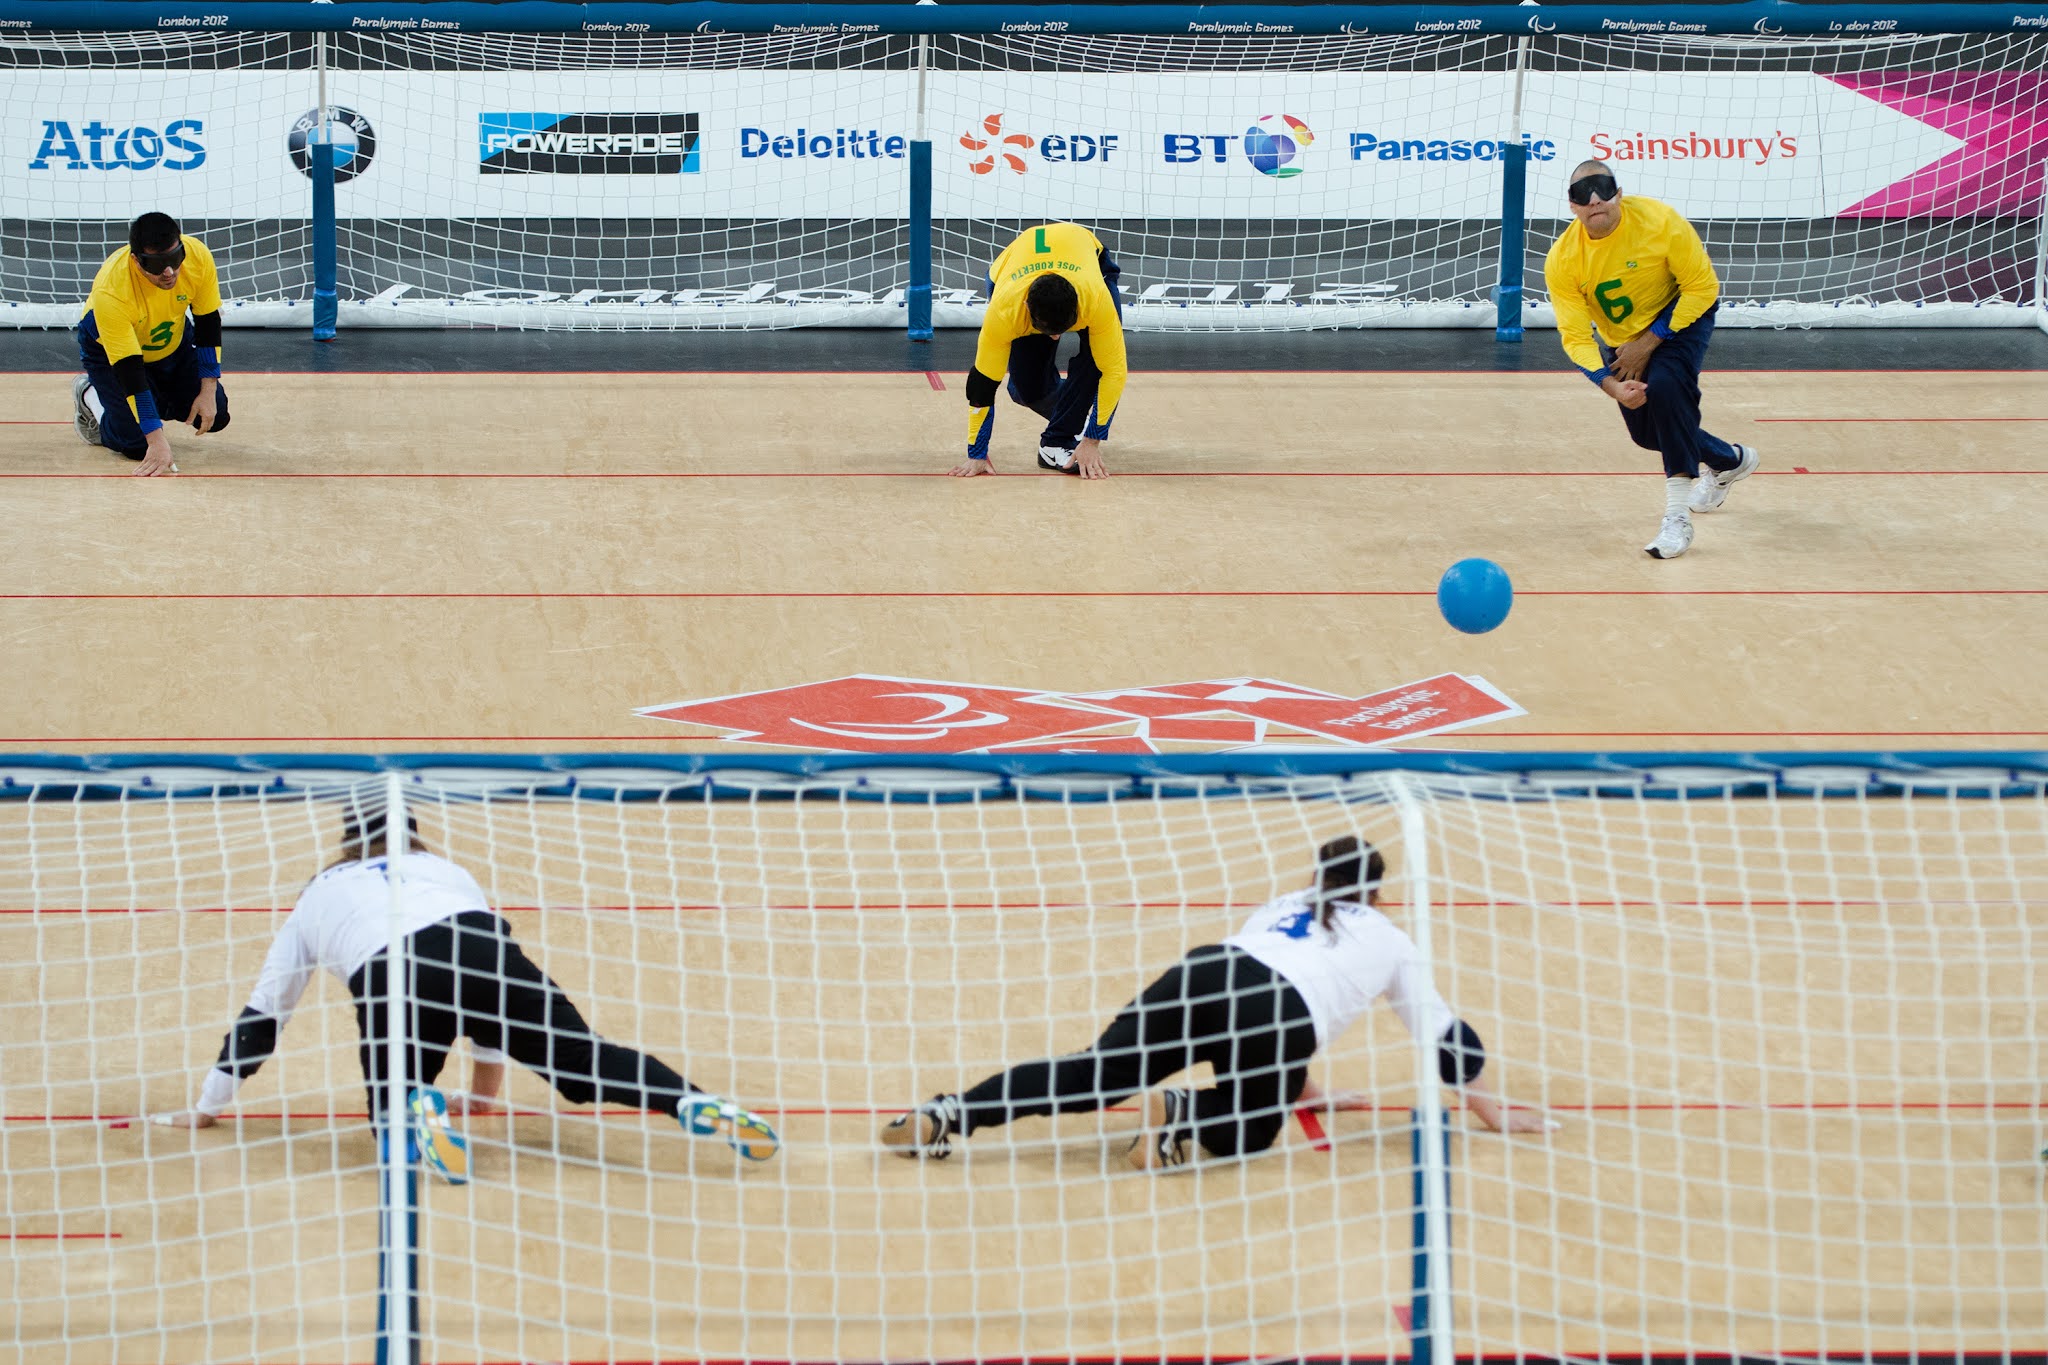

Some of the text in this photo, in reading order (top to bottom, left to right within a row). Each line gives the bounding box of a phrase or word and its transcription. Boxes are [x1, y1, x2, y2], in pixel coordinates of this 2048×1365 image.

[0, 19, 33, 29] ames
[157, 14, 229, 27] London 2012
[351, 16, 460, 31] Paralympic Games
[582, 21, 651, 32] London 2012
[772, 23, 880, 35] Paralympic Games
[1001, 21, 1069, 32] London 2012
[1187, 21, 1294, 34] Paralympic Games
[1414, 19, 1482, 32] London 2012
[1601, 18, 1707, 33] Paralympic Games
[1871, 19, 1898, 31] 2012
[296, 108, 369, 133] BMW
[486, 133, 684, 153] POWERADE
[741, 128, 906, 158] Deloitte
[1163, 134, 1239, 163] BT
[1349, 133, 1556, 161] Panasoic
[1035, 228, 1051, 254] 1
[1011, 261, 1081, 281] JOSE ROBERTO
[1594, 278, 1634, 324] 6
[141, 321, 175, 351] 3
[1322, 689, 1442, 728] Paralympic
[1368, 705, 1449, 730] Games
